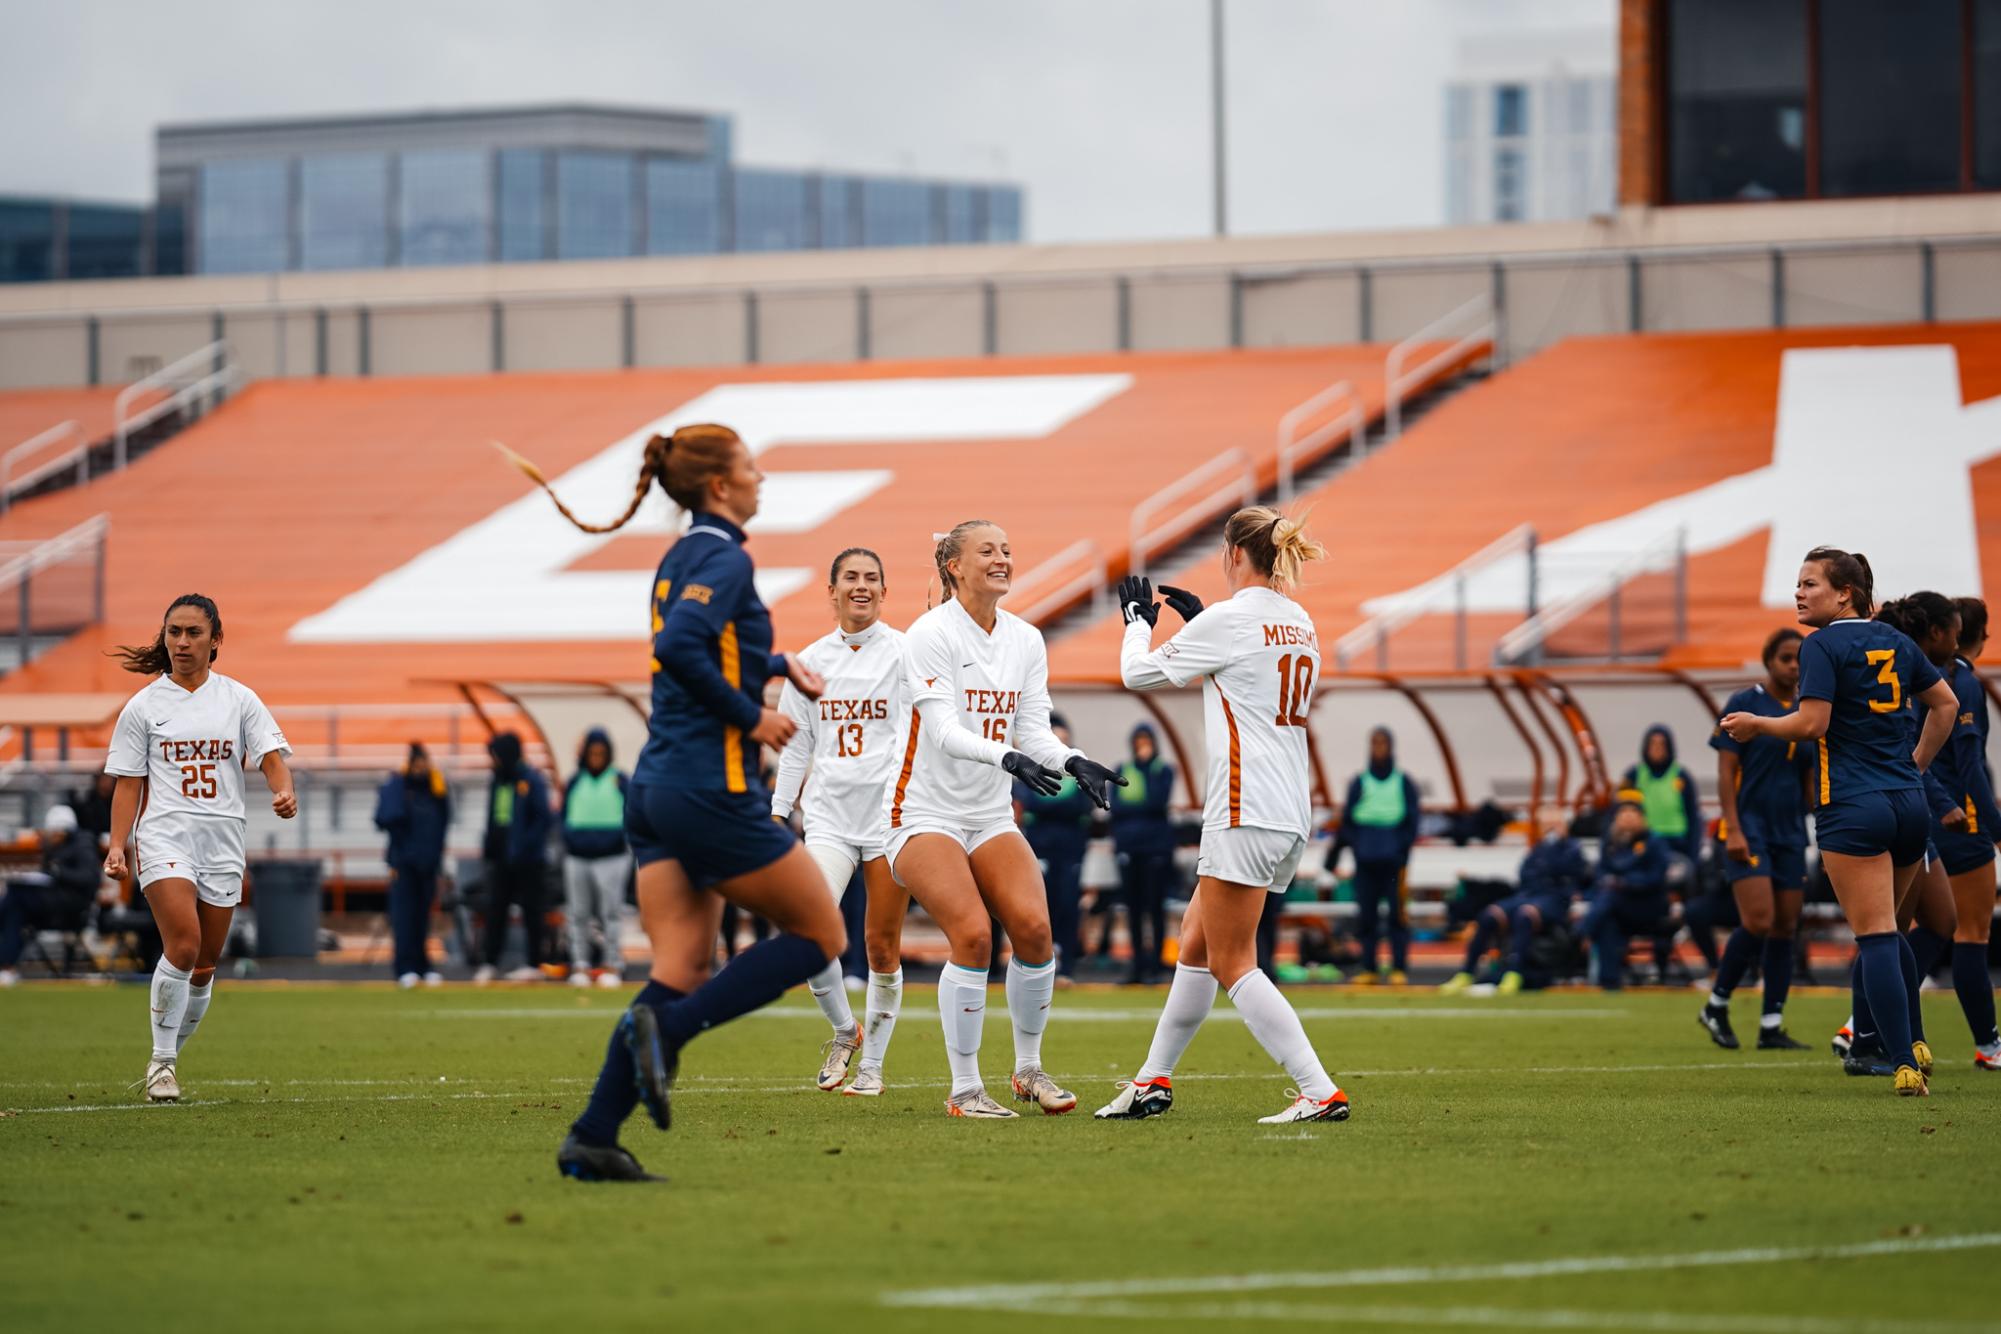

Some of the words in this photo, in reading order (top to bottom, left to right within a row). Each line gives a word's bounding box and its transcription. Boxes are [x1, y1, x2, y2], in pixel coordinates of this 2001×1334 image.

[1275, 653, 1313, 727] 10
[1865, 649, 1900, 714] 3
[820, 699, 888, 721] TEXAS
[837, 723, 863, 757] 13
[982, 718, 1008, 744] 16
[160, 739, 233, 762] TEXAS
[181, 764, 217, 799] 25
